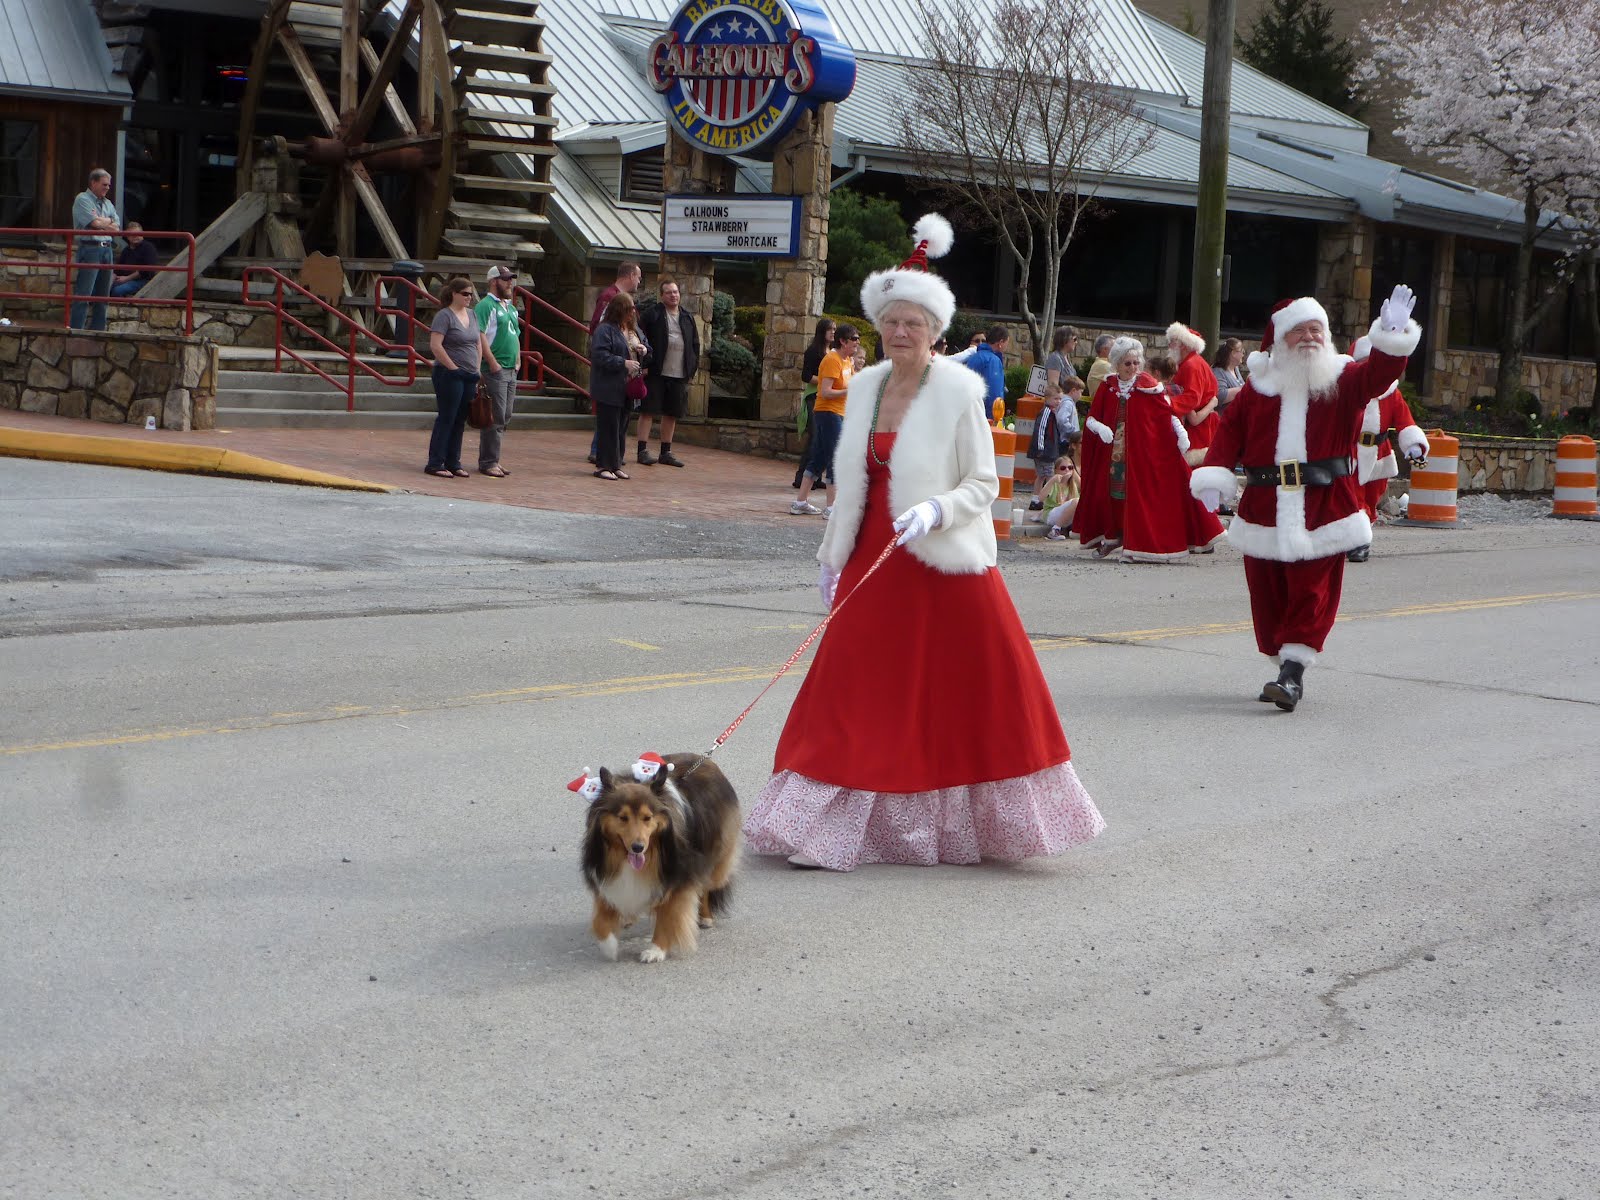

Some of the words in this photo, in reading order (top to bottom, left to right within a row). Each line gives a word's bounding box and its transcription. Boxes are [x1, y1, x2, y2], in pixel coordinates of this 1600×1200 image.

[646, 29, 814, 94] CALHOUN'S
[674, 100, 697, 129] IN
[695, 105, 783, 148] AMERICA
[683, 206, 729, 218] CALHOUNS
[692, 220, 749, 232] STRAWBERRY
[727, 235, 778, 247] SHORTCAKE
